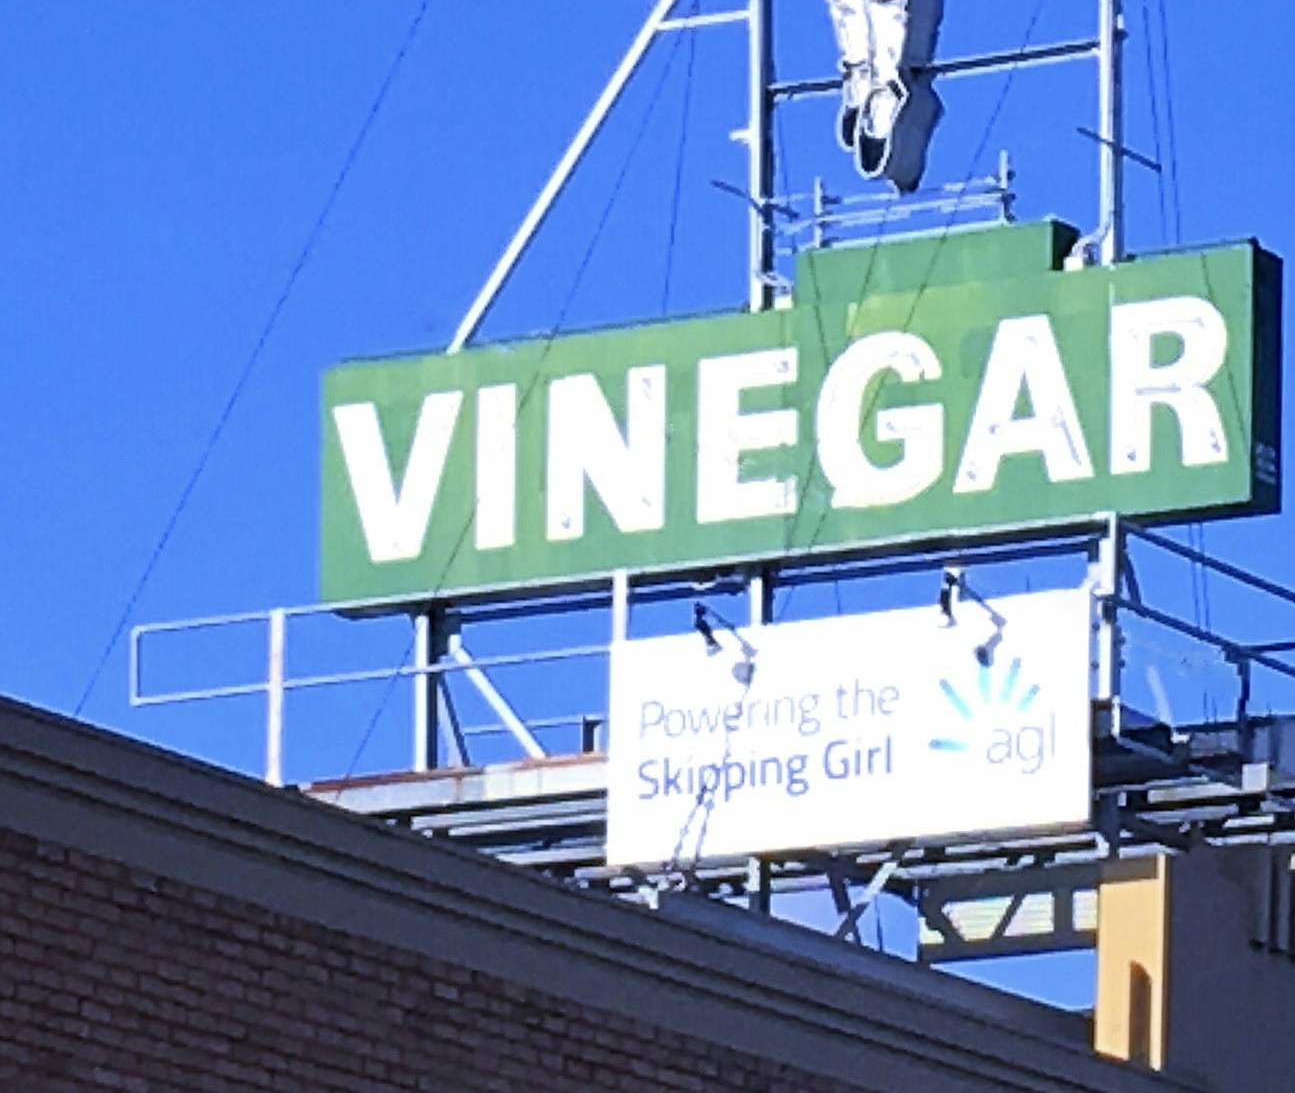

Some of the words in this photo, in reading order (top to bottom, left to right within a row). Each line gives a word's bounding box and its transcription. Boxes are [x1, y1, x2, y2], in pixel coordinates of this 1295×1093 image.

[332, 295, 1229, 563] VINEGAR
[639, 693, 820, 738] Powering
[836, 678, 900, 720] the
[638, 752, 809, 800] Skipping
[823, 735, 893, 780] Girl
[986, 711, 1056, 775] agl
